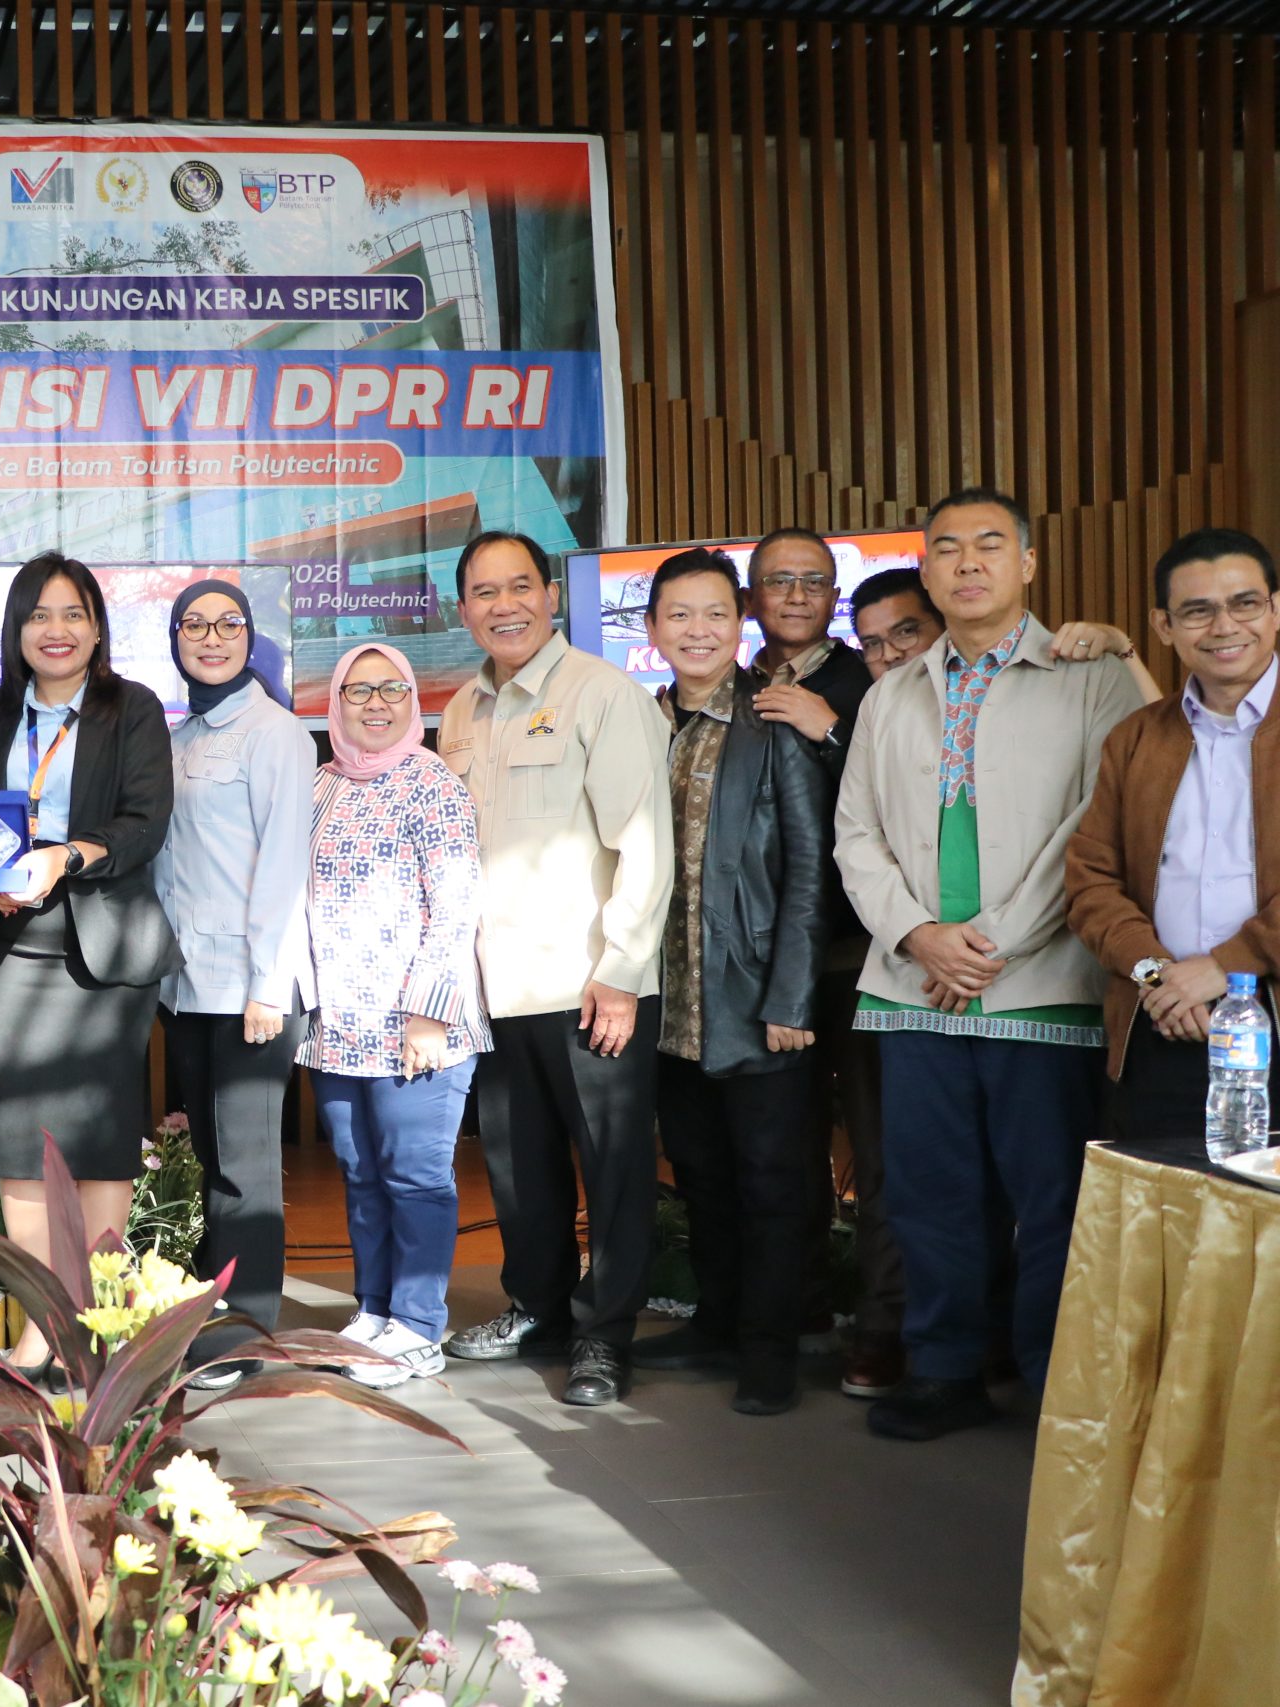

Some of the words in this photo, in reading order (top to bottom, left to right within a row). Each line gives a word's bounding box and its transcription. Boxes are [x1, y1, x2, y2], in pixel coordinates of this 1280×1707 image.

[279, 174, 336, 194] BTP
[1, 288, 186, 312] KUNJUNGAN
[195, 288, 285, 310] KERJA
[293, 287, 410, 311] SPESIFIK
[131, 365, 256, 431] VII
[271, 364, 448, 429] DPR
[463, 365, 552, 429] RI
[26, 457, 112, 477] Batam
[121, 455, 222, 476] Tourism
[229, 453, 380, 478] Polytechnic
[292, 564, 341, 584] 026
[318, 591, 431, 611] Polytechnic
